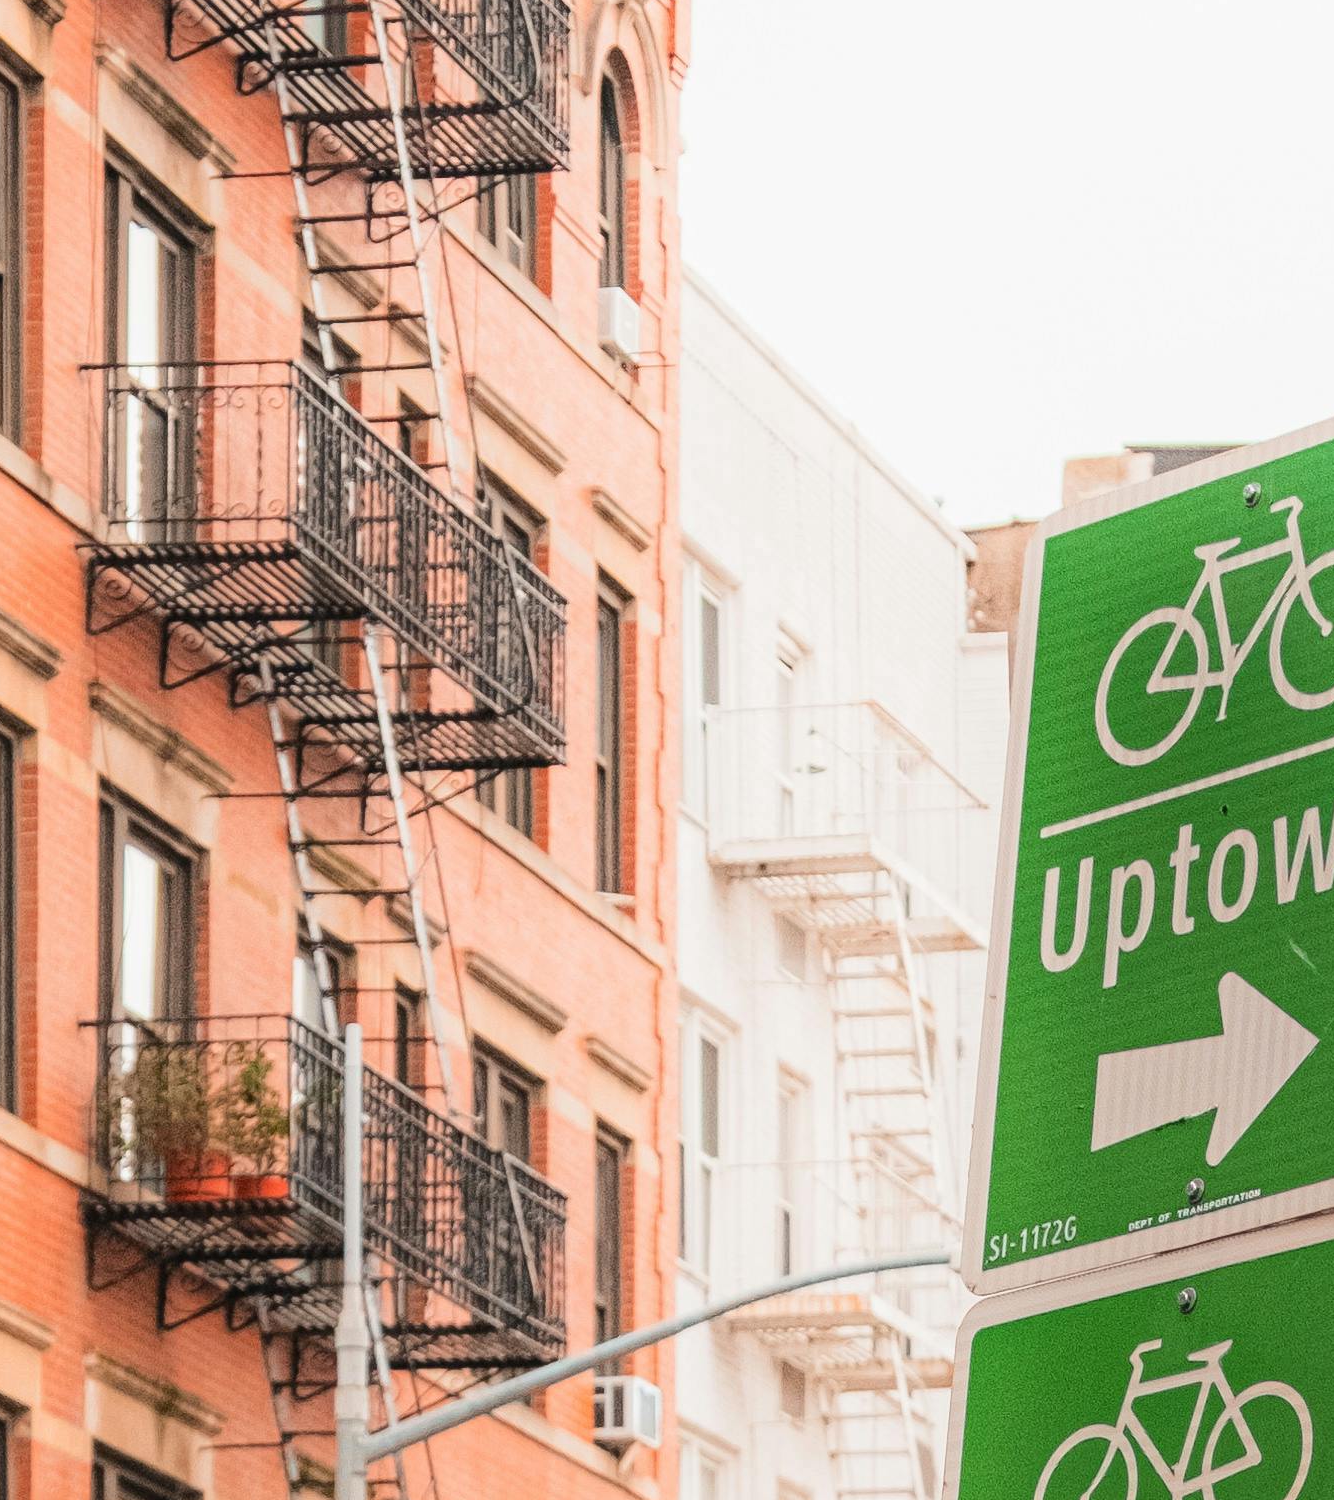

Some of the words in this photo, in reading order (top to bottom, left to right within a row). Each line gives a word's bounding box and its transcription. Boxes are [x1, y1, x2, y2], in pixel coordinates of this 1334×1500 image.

[1128, 1216, 1153, 1232] DEPT
[1158, 1212, 1172, 1223] OF
[1177, 1188, 1261, 1219] TRANSPORTATION
